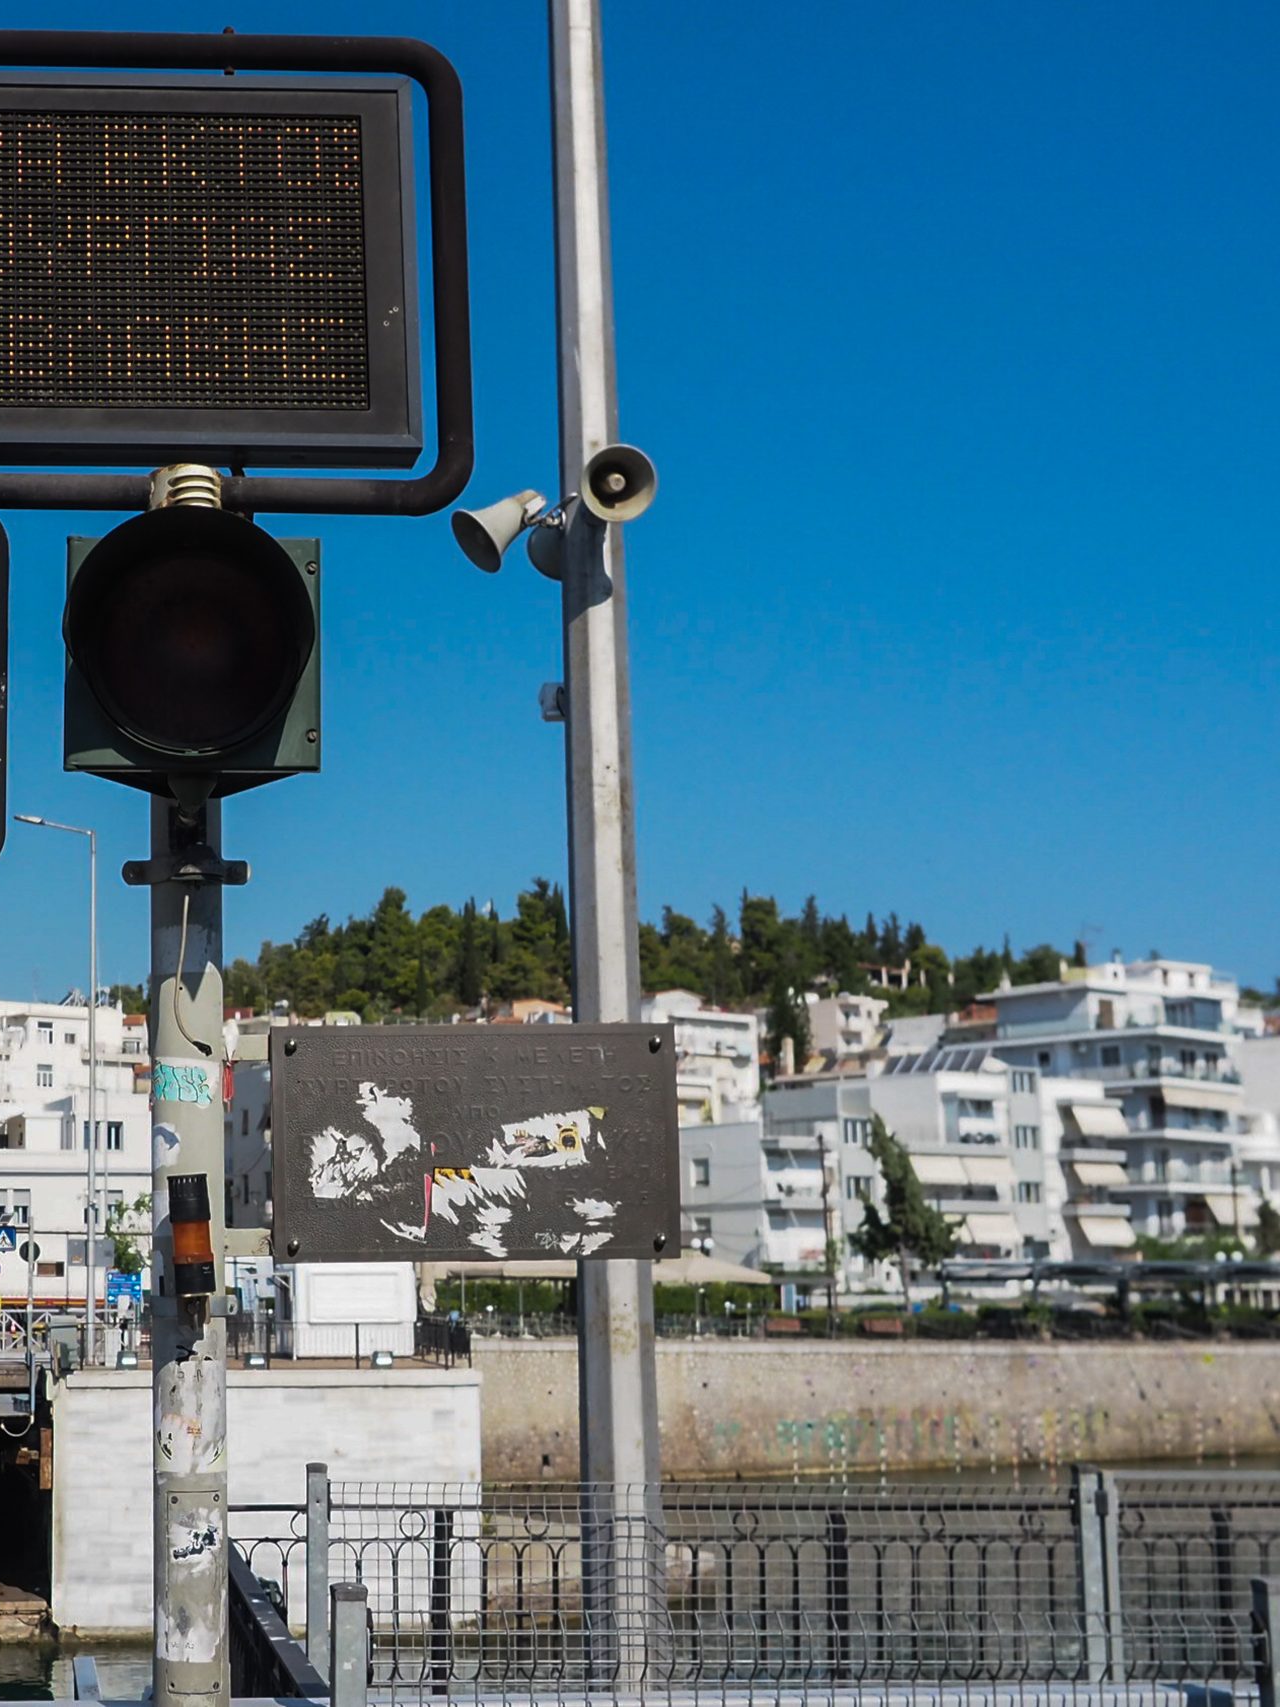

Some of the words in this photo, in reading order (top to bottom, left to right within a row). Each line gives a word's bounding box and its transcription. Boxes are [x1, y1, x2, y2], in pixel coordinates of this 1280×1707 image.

[103, 124, 359, 187] ΕΚΤΟΣ
[8, 313, 346, 379] ΒΛΑΒΗΣ
[301, 1075, 469, 1096] ΣΥΡΤΡΩΤΟΥ
